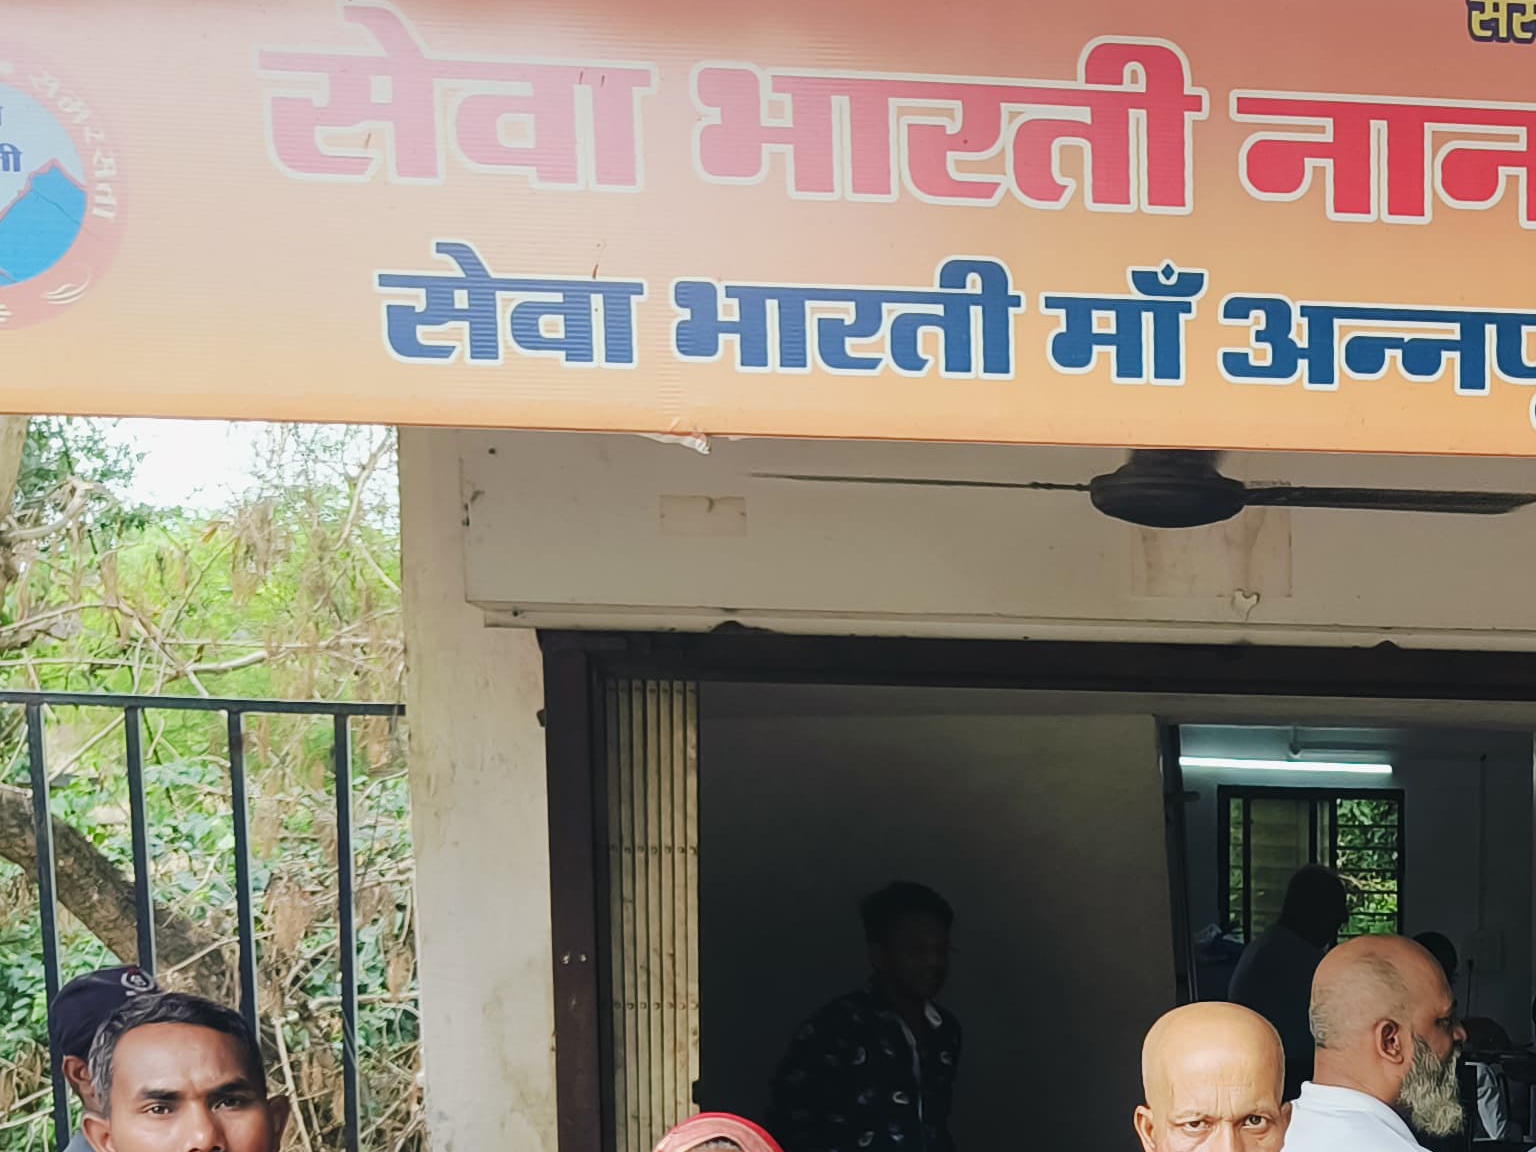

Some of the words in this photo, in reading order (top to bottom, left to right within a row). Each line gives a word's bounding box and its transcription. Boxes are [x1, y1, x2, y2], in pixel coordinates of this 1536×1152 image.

[253, 0, 660, 191] सेवा
[691, 36, 1209, 215] भारती
[375, 239, 648, 369] सेवा
[672, 255, 1026, 380] भारती
[1040, 258, 1208, 386] माँ
